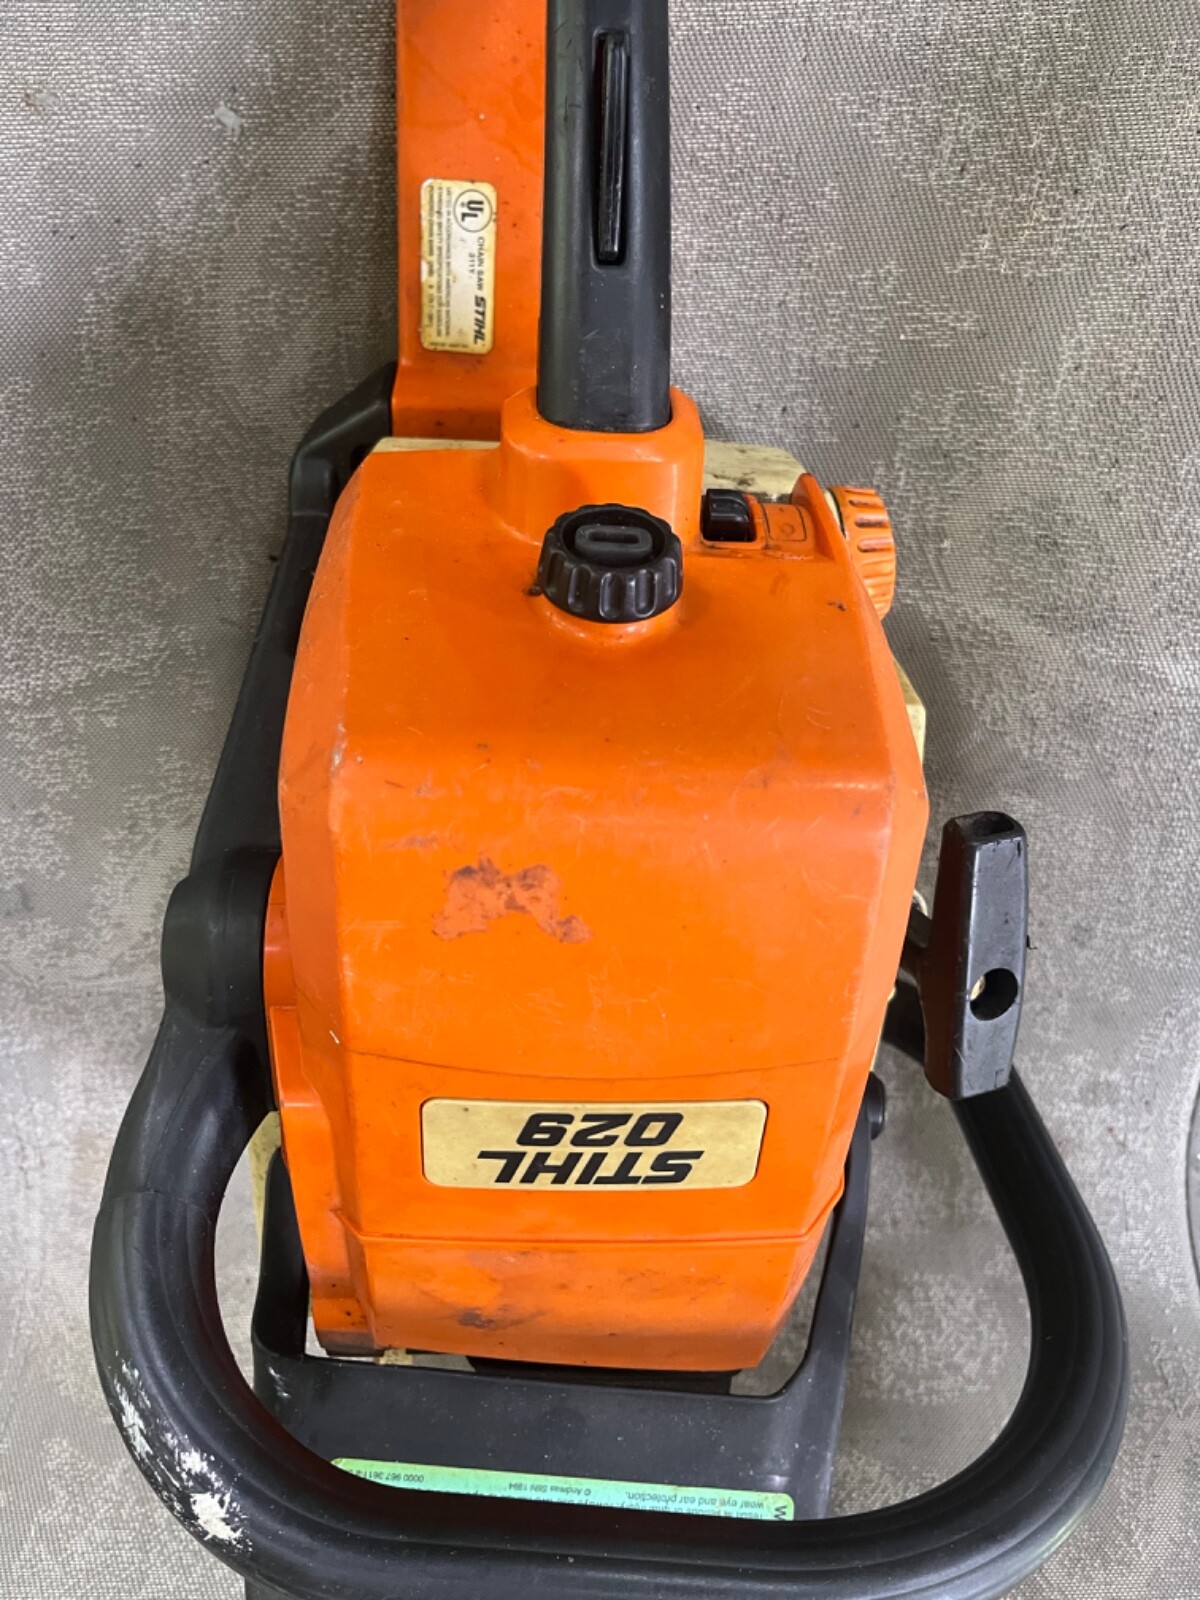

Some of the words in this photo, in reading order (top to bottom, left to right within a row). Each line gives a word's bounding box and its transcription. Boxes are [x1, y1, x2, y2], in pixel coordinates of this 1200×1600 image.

[461, 199, 485, 222] UL
[477, 236, 485, 267] CHAIN
[476, 269, 484, 292] SAW
[473, 295, 486, 345] STIHL
[515, 1112, 684, 1147] 029
[477, 1150, 705, 1185] STIHL
[550, 1485, 583, 1496] Andreas
[624, 1490, 677, 1504] protection.
[680, 1495, 696, 1505] ear
[698, 1496, 717, 1507] and
[719, 1497, 737, 1508] eye
[741, 1500, 764, 1510] wear
